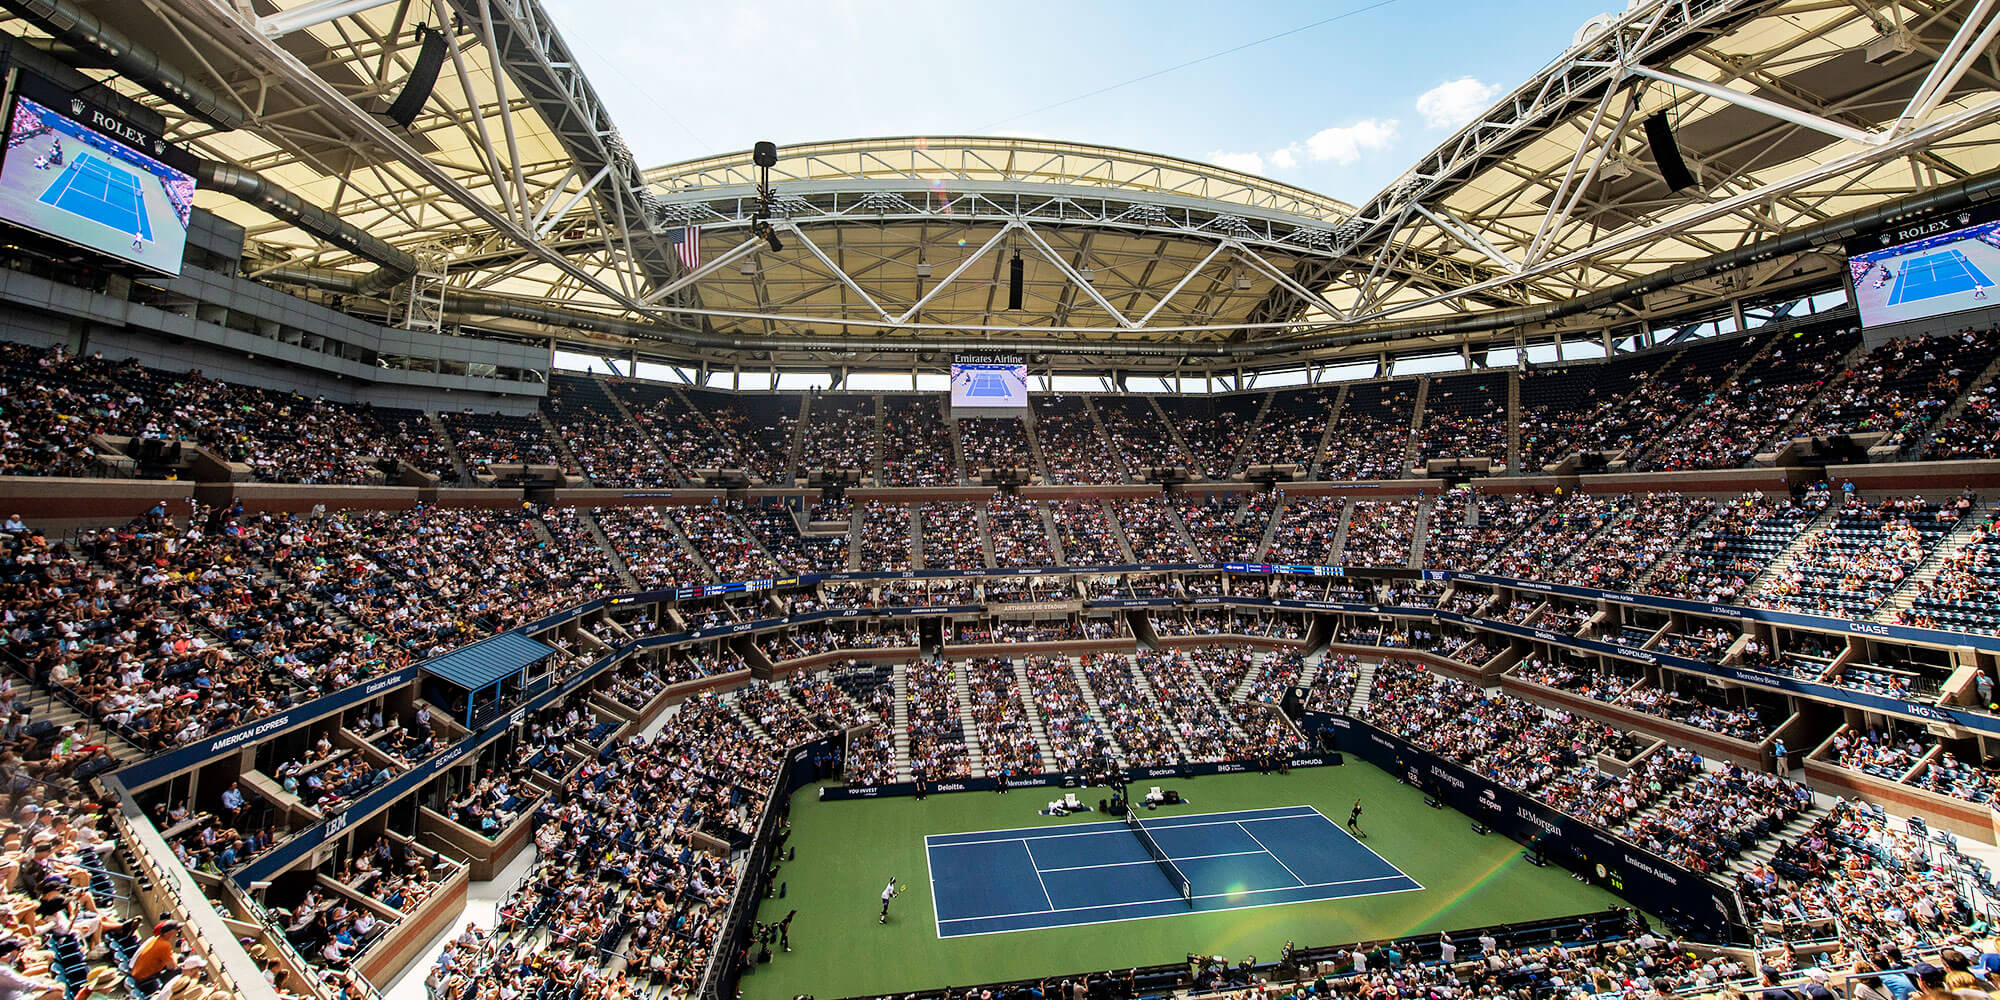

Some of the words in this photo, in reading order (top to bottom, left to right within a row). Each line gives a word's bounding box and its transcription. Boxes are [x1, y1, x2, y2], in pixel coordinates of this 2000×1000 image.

[92, 109, 147, 147] ROLEX
[1898, 219, 1951, 241] ROLEX
[954, 353, 992, 363] Emirates
[993, 353, 1023, 364] Airline
[733, 624, 752, 632] CHASE
[1849, 623, 1889, 635] CHASE
[1736, 671, 1780, 686] Mercedes-Benz
[211, 728, 255, 752] AMERICAN
[255, 715, 289, 735] EXPRESS
[435, 747, 463, 769] BERMUDA
[1292, 758, 1323, 767] BERMUDA
[1007, 778, 1046, 787] Mercedes-Benz
[324, 811, 348, 838] IBM
[1516, 806, 1562, 837] J.P.Morgan
[1624, 854, 1653, 874] Emirates
[1653, 867, 1678, 886] Airline
